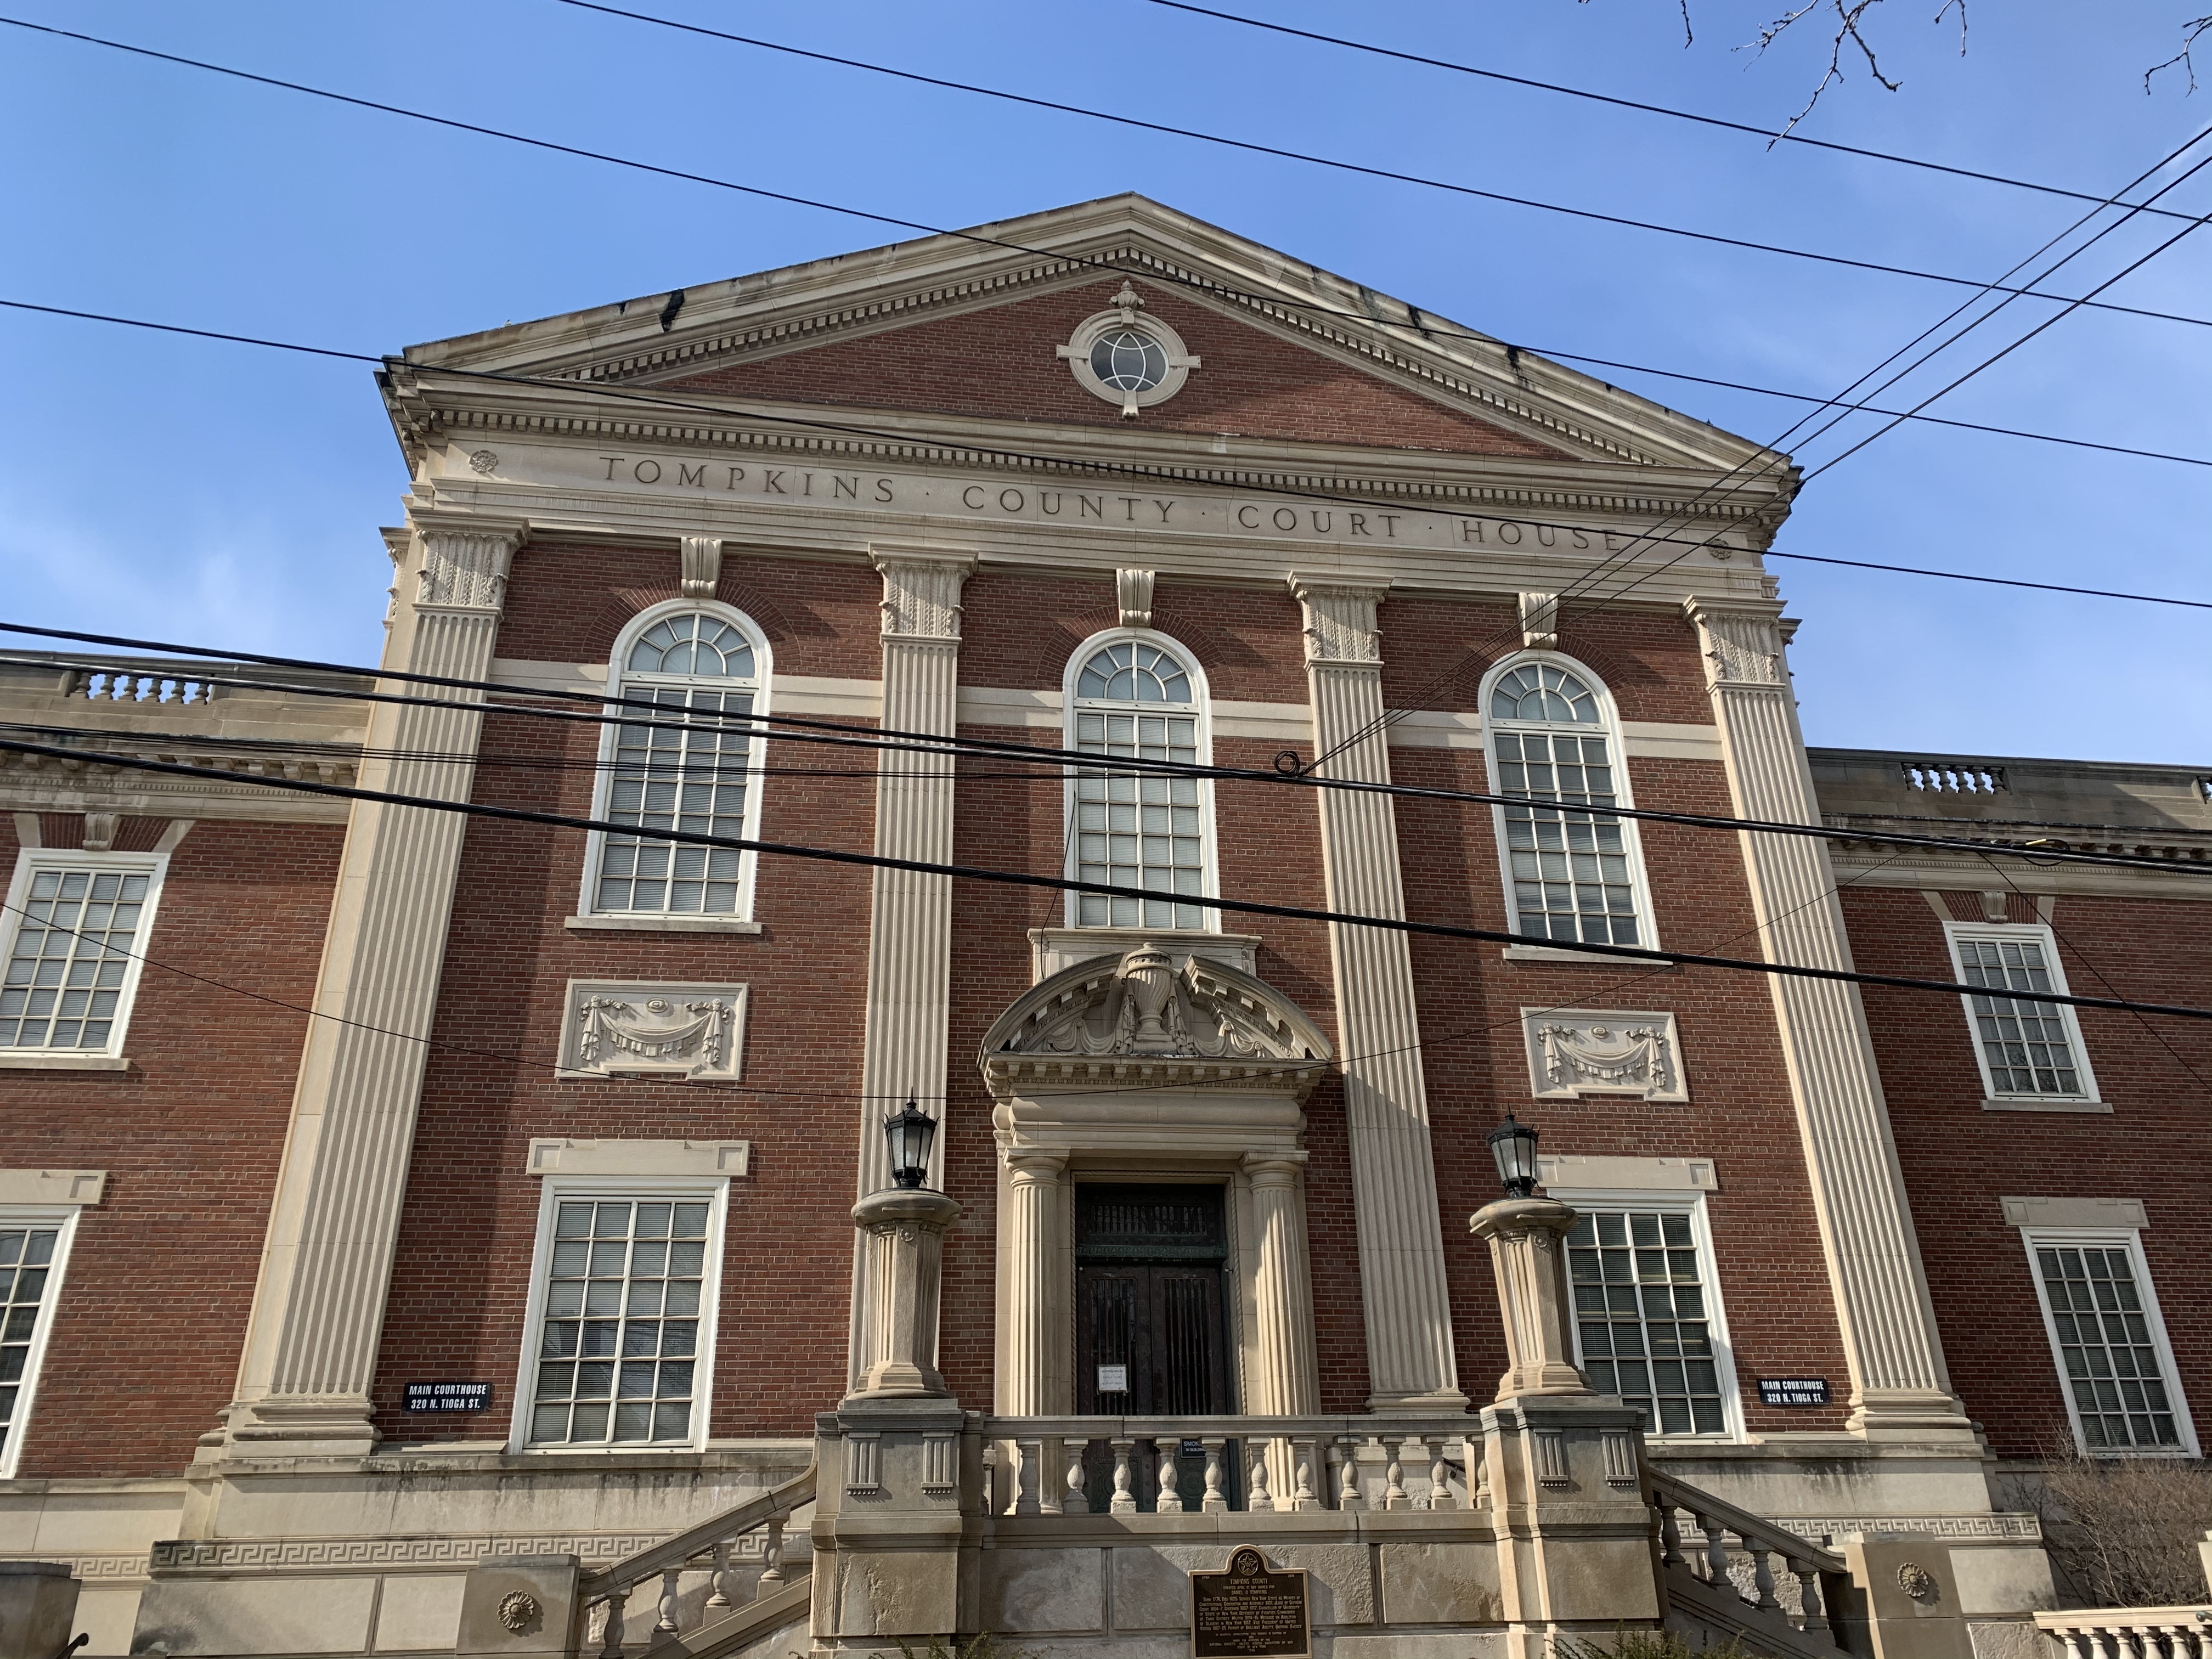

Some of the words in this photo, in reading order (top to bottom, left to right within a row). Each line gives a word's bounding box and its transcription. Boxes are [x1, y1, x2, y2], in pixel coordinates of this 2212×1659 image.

[599, 456, 893, 503] TOMPKINS
[963, 486, 1177, 523] COUNTY
[1238, 505, 1400, 538] COURT
[1460, 519, 1621, 552] HOUSE
[409, 1385, 432, 1395] MAIN
[435, 1385, 487, 1395] COURTHOUSE
[1762, 1381, 1781, 1390] MAIN
[1782, 1381, 1824, 1390] COURTHOUSE
[1767, 1393, 1781, 1402] 320
[1782, 1393, 1791, 1402] N.
[1791, 1393, 1812, 1402] TIOGA
[1813, 1393, 1823, 1402] ST.
[411, 1400, 426, 1409] 320
[430, 1399, 438, 1409] N.
[441, 1399, 465, 1409] TIOGA
[468, 1398, 480, 1408] ST.
